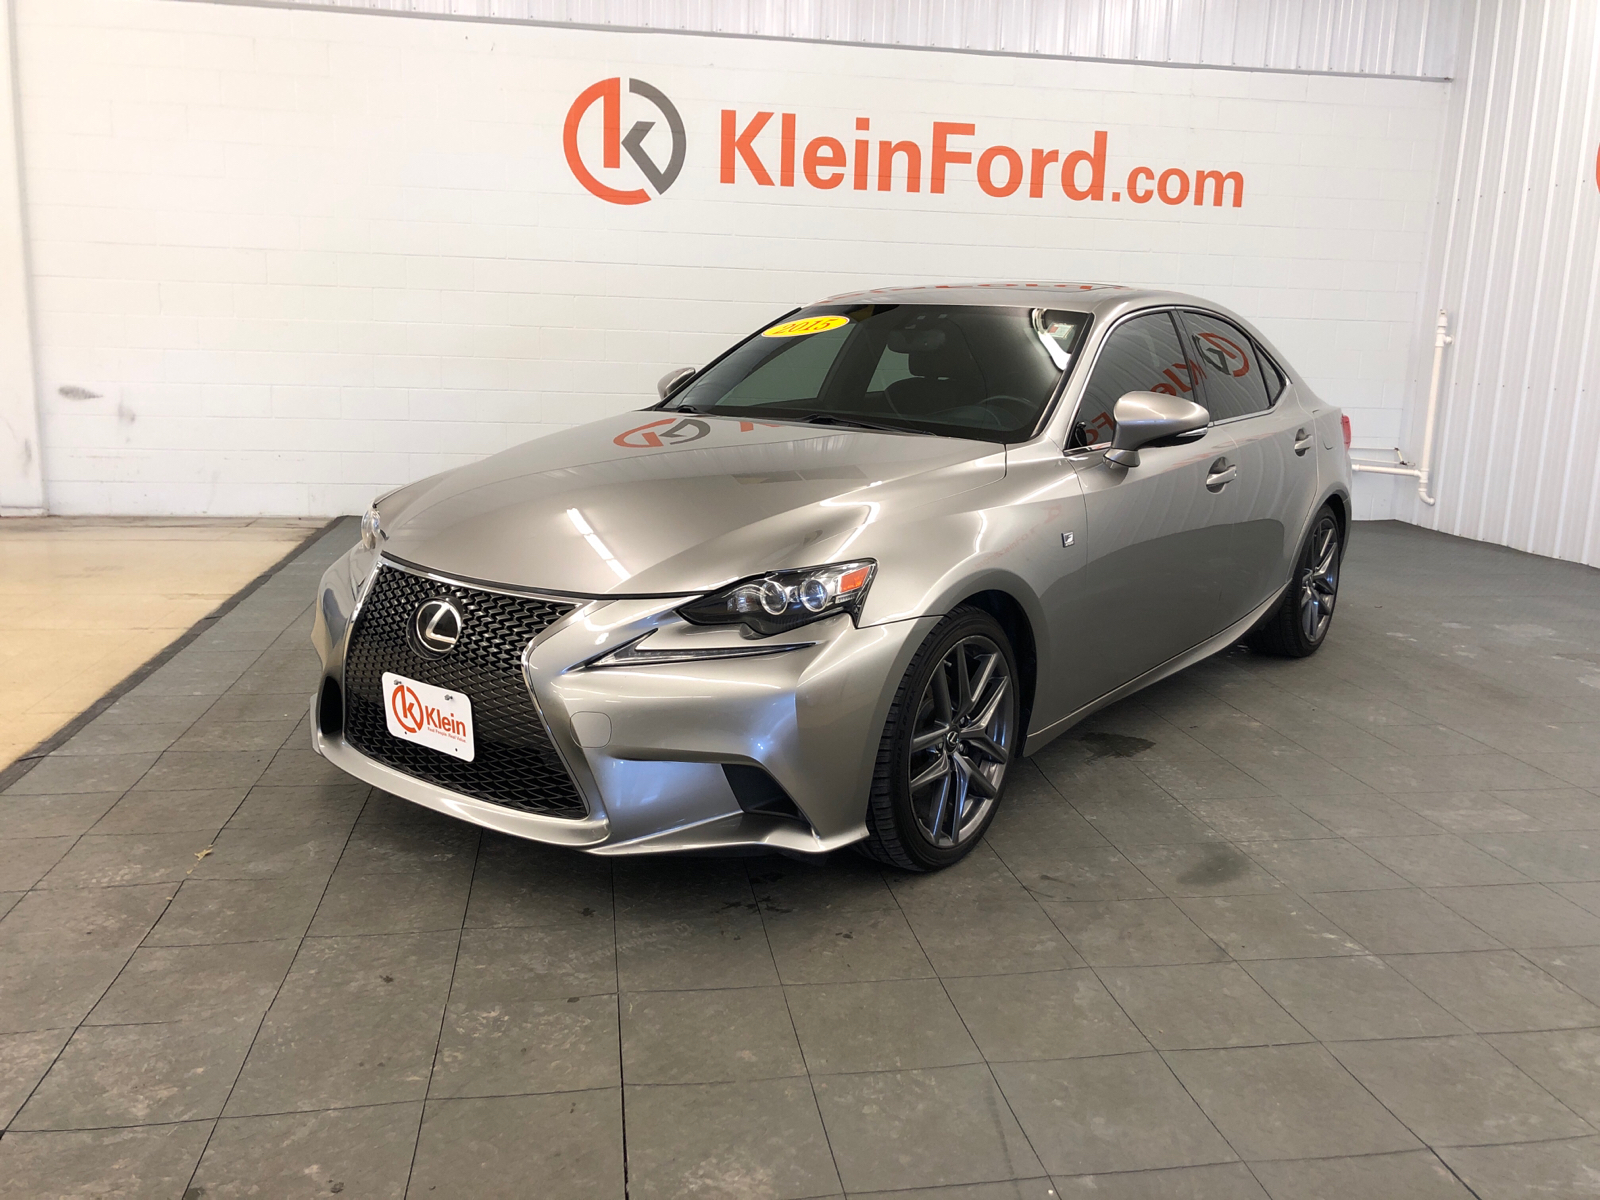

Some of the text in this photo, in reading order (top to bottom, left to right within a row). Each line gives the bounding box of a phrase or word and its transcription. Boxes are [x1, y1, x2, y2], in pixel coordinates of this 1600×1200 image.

[720, 109, 1244, 208] KleinFord.com
[772, 318, 839, 336] 2015
[424, 705, 467, 738] Klein
